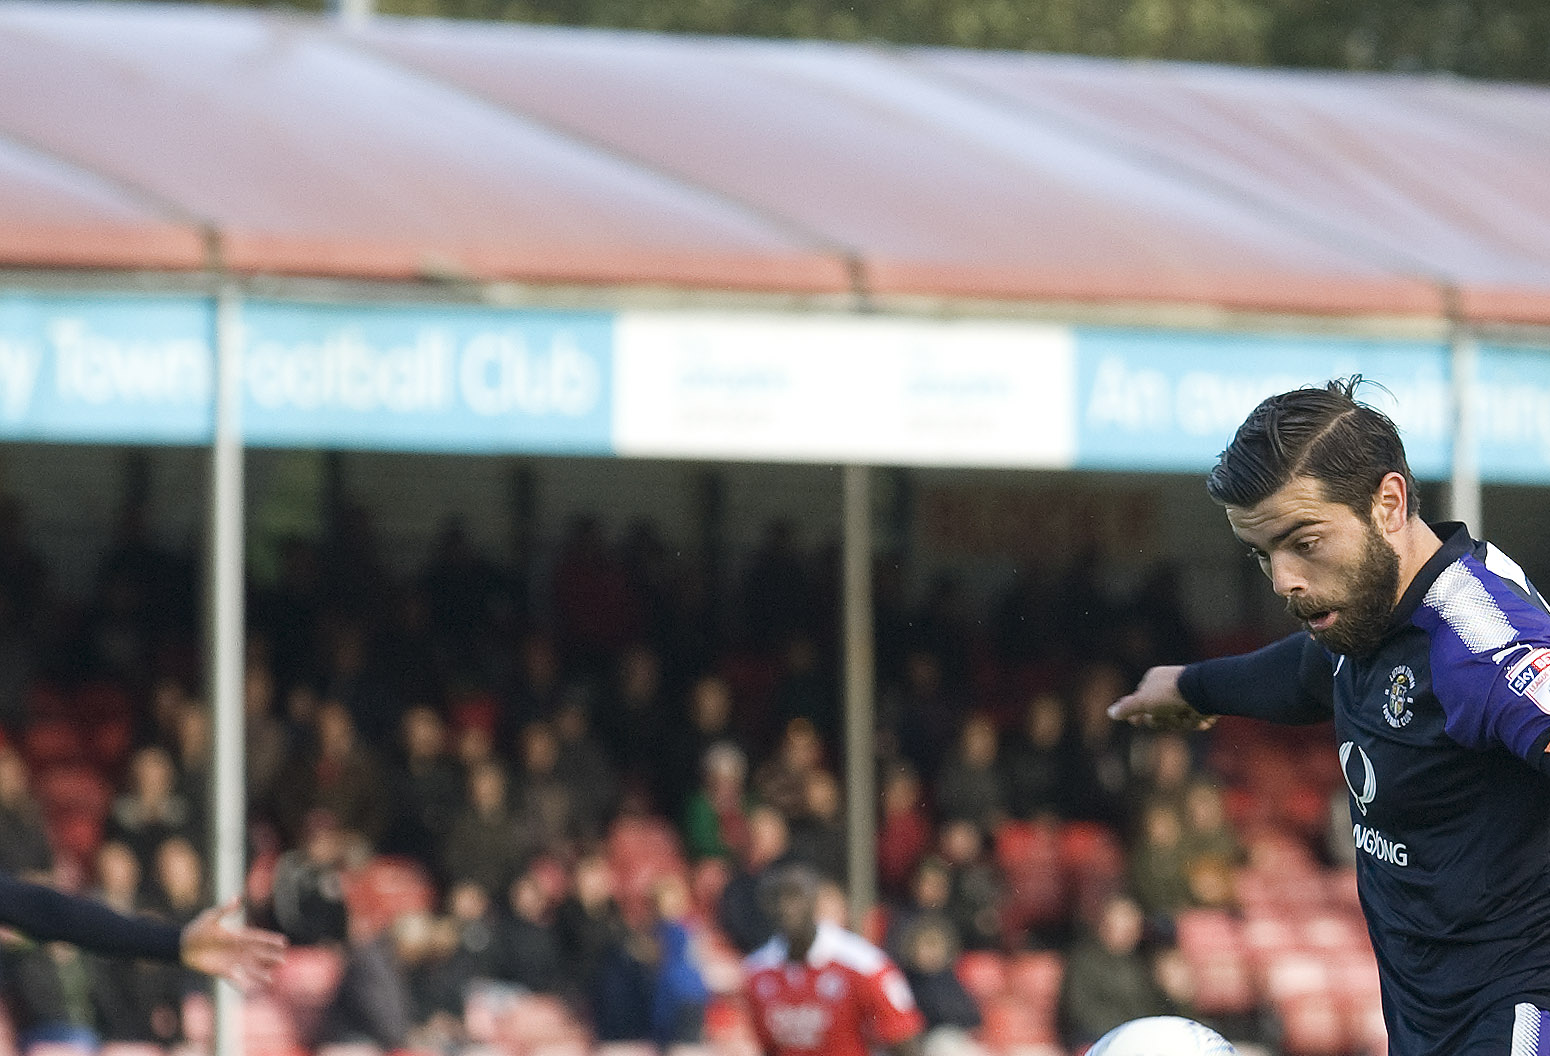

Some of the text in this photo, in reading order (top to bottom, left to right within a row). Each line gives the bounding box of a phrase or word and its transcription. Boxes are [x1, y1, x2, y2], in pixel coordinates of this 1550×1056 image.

[50, 318, 209, 406] Town
[243, 325, 454, 412] ootball
[460, 331, 600, 417] Club
[1514, 667, 1535, 691] sky
